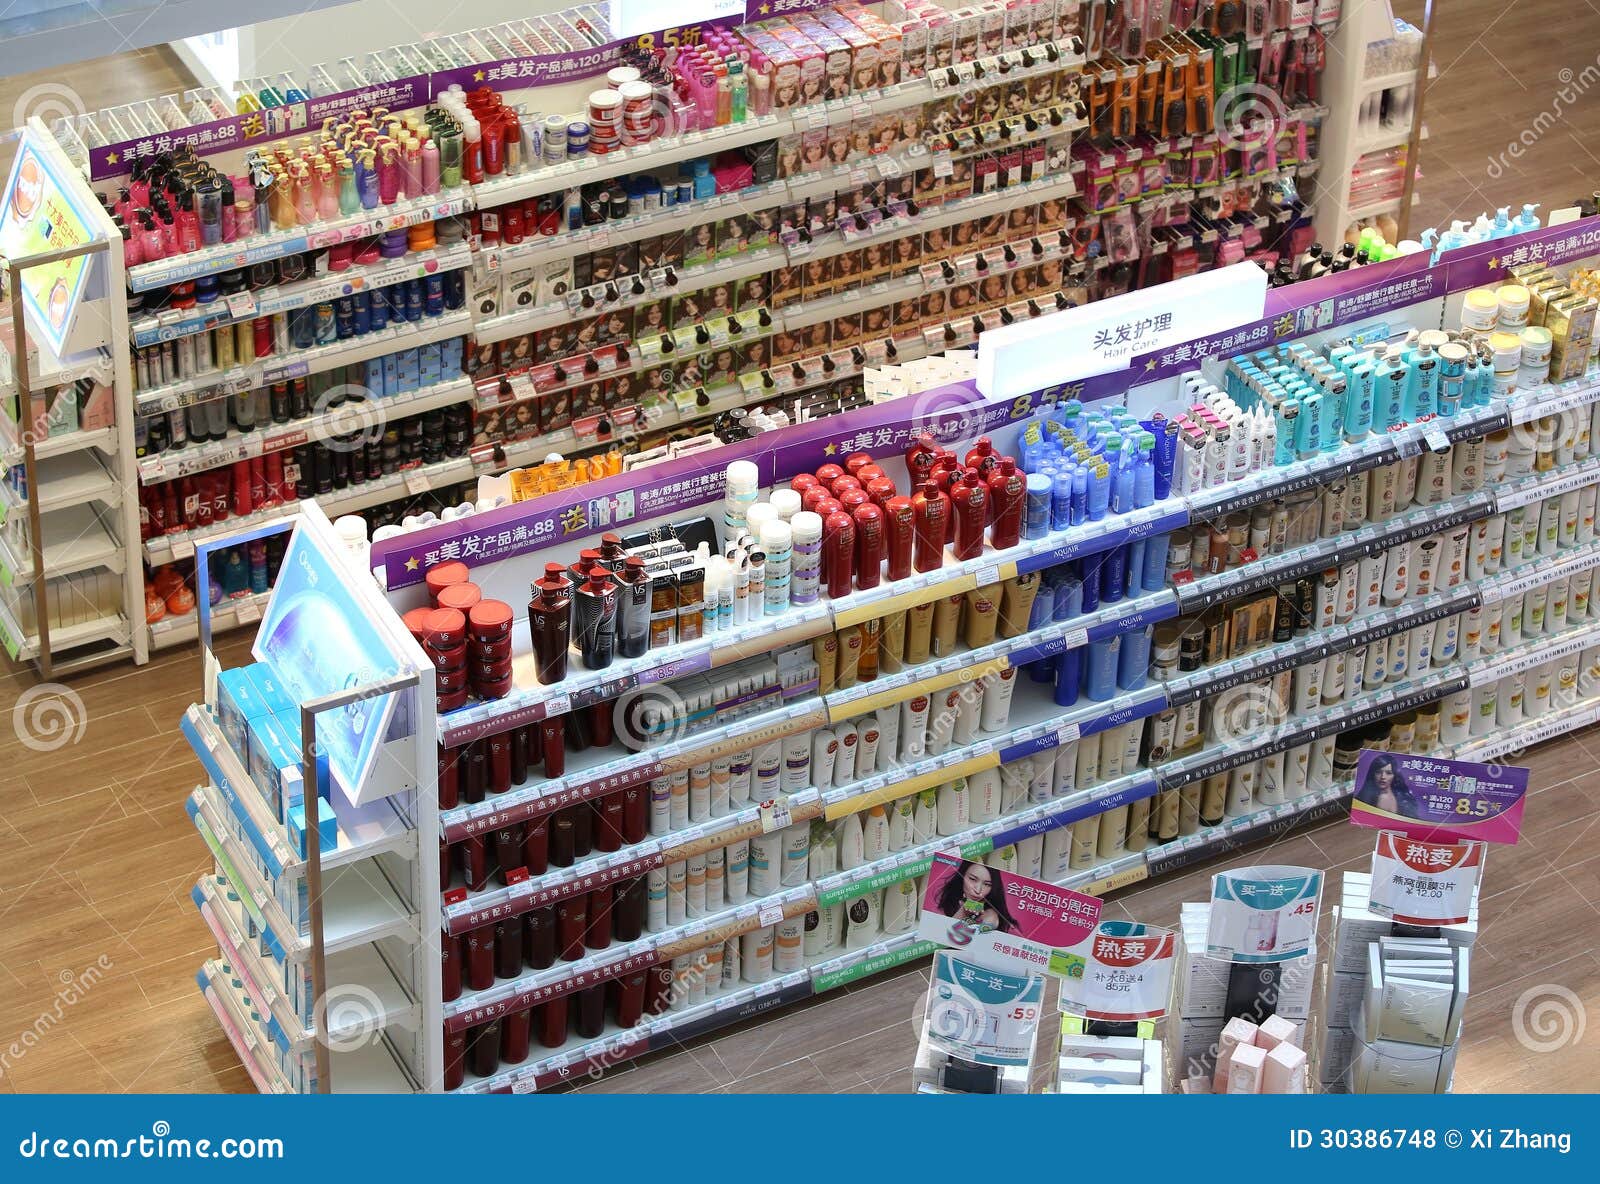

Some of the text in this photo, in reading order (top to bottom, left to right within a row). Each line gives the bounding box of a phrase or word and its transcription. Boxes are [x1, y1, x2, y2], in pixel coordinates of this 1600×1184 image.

[239, 113, 267, 141] 送
[1093, 311, 1173, 350] 头发护理
[1271, 313, 1296, 340] 送
[1103, 337, 1159, 359] Hair Care
[559, 504, 588, 537] 送
[1128, 522, 1154, 536] AQUAIR
[1053, 544, 1079, 558] AQUAIR
[1118, 614, 1143, 628] AQUAIR
[1044, 638, 1066, 651] AQUAI
[1108, 709, 1133, 723] AQUAIR
[1035, 732, 1060, 747] AQUAI
[1099, 793, 1124, 808] AQUAIR
[466, 812, 509, 833] 创新配方
[1027, 817, 1053, 832] AQUAIR
[1404, 843, 1454, 867] 热卖
[1241, 884, 1298, 897] 买一送一
[1007, 881, 1099, 919] 会员迈向5周年!
[470, 903, 512, 923] 创新配方
[1096, 939, 1146, 960] 热卖
[960, 967, 1019, 992] 买一送一
[1095, 973, 1144, 984] 补水8送4
[1105, 982, 1131, 992] 85元
[464, 1003, 505, 1023] 创新配方
[558, 1067, 570, 1076] VS
